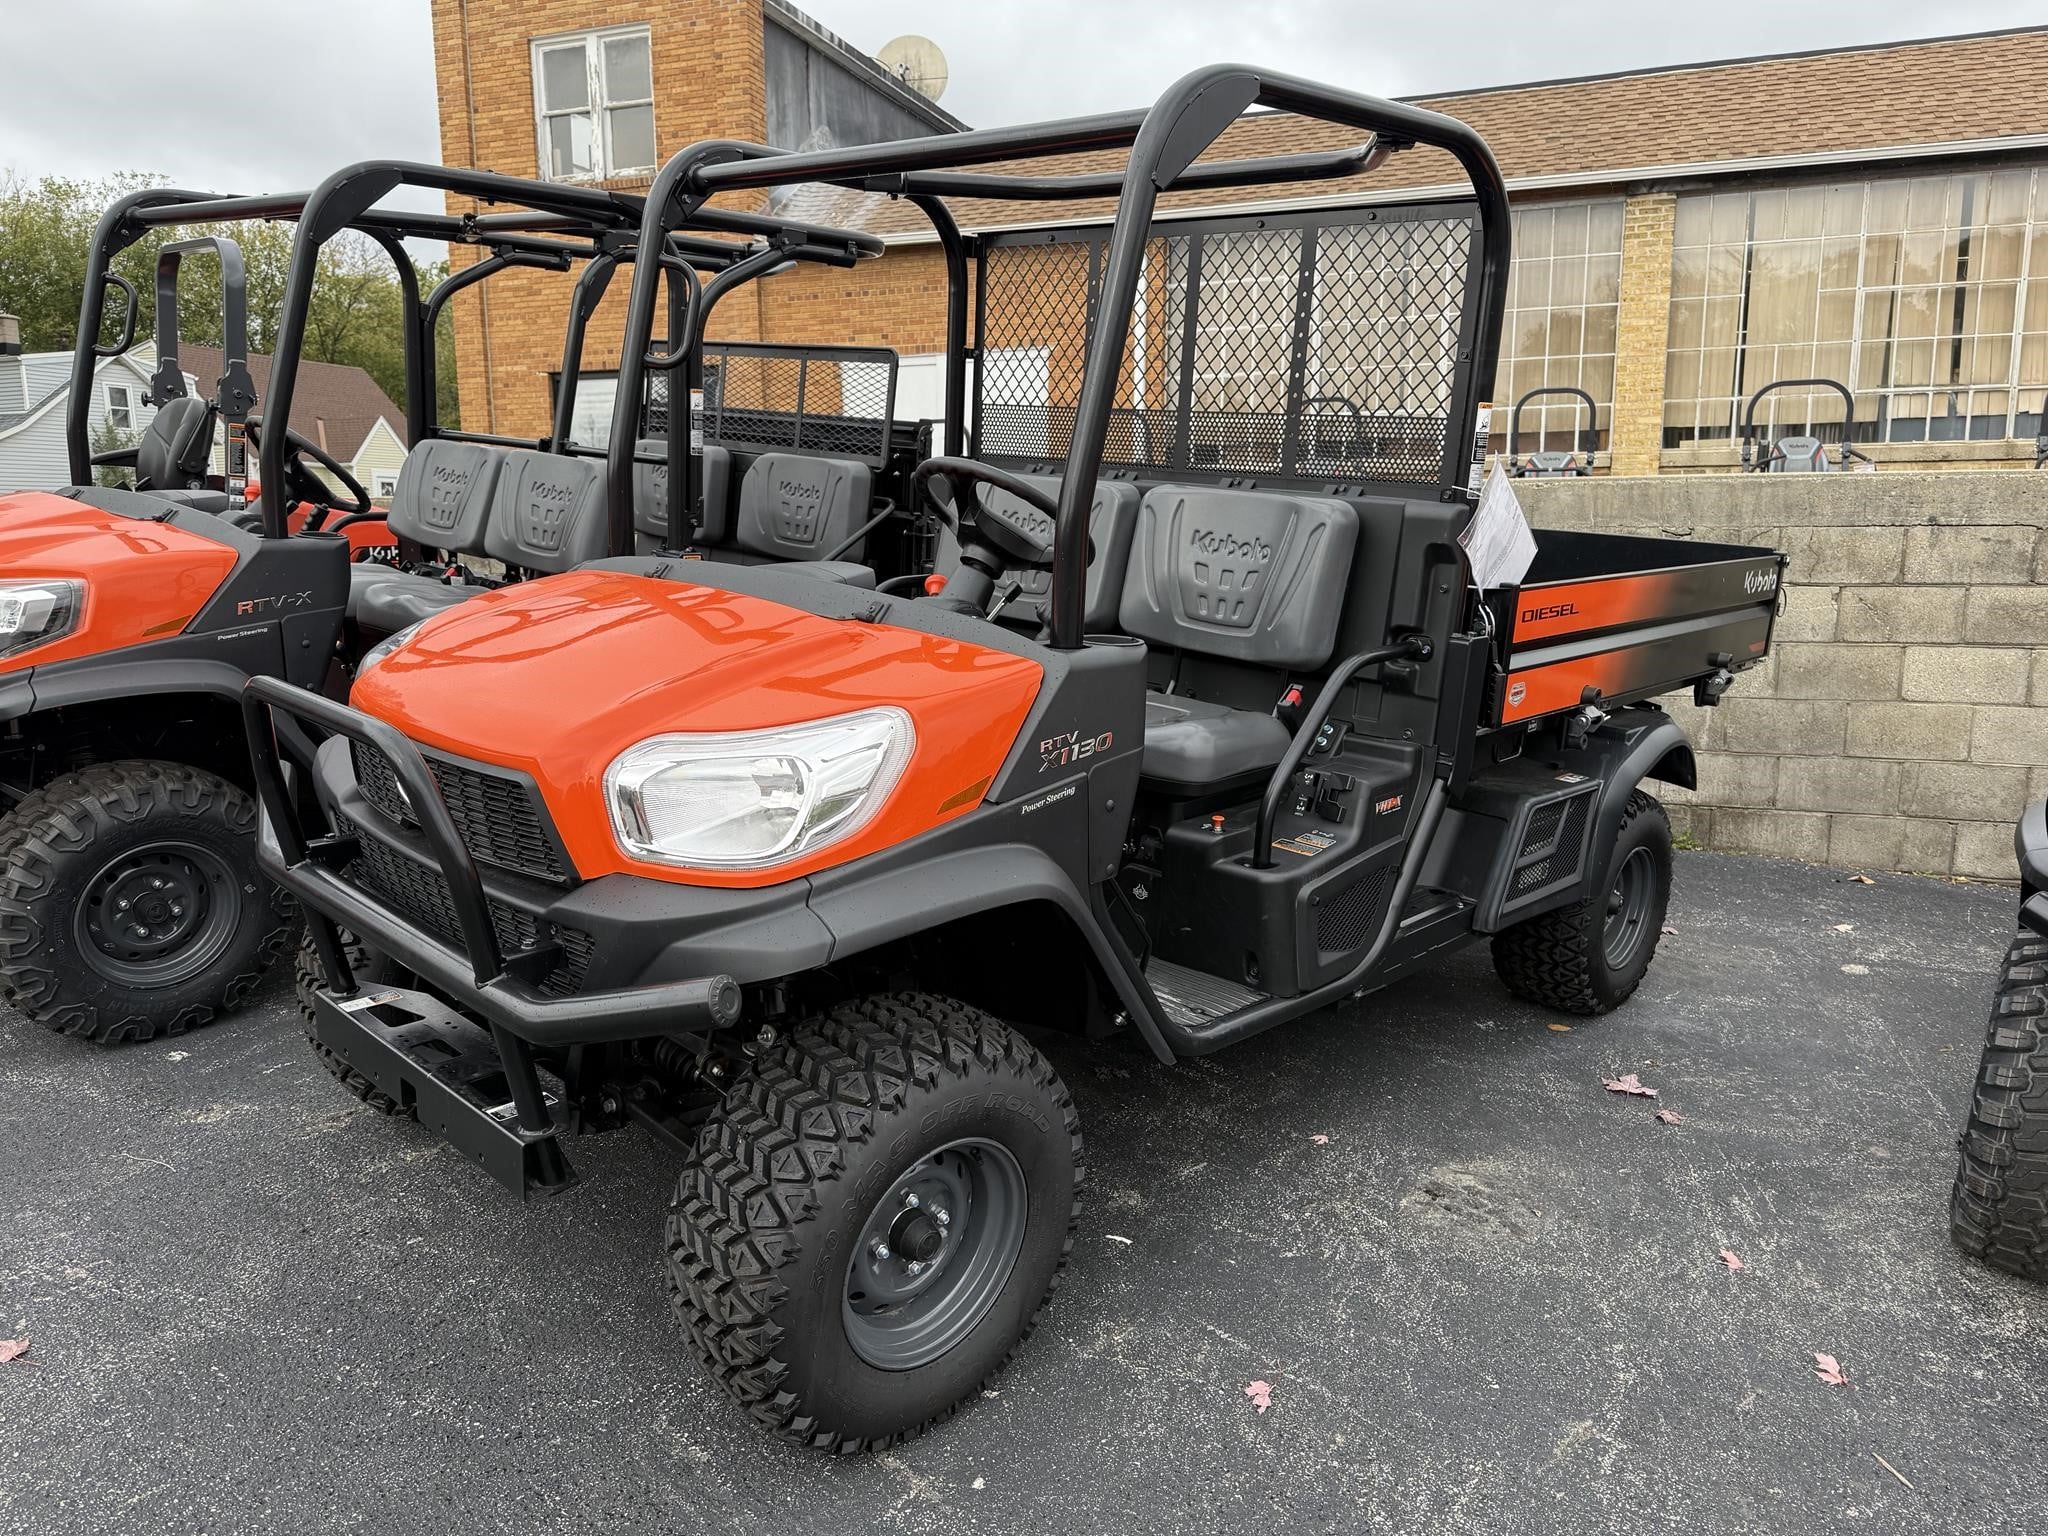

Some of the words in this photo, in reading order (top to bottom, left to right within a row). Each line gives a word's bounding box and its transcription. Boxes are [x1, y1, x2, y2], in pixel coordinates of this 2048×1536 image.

[779, 480, 820, 501] Kubota
[1191, 528, 1272, 564] Kubota
[1743, 567, 1778, 595] Kubota
[237, 590, 312, 616] RTV-X
[1521, 602, 1579, 623] DIESEL
[217, 633, 240, 641] Power
[239, 627, 268, 638] Steering
[1038, 731, 1113, 773] X1130
[1040, 730, 1080, 754] RTV
[1021, 798, 1047, 815] Power
[1045, 786, 1076, 805] Steering
[919, 1093, 984, 1135] OFF
[983, 1092, 1050, 1134] ROAD
